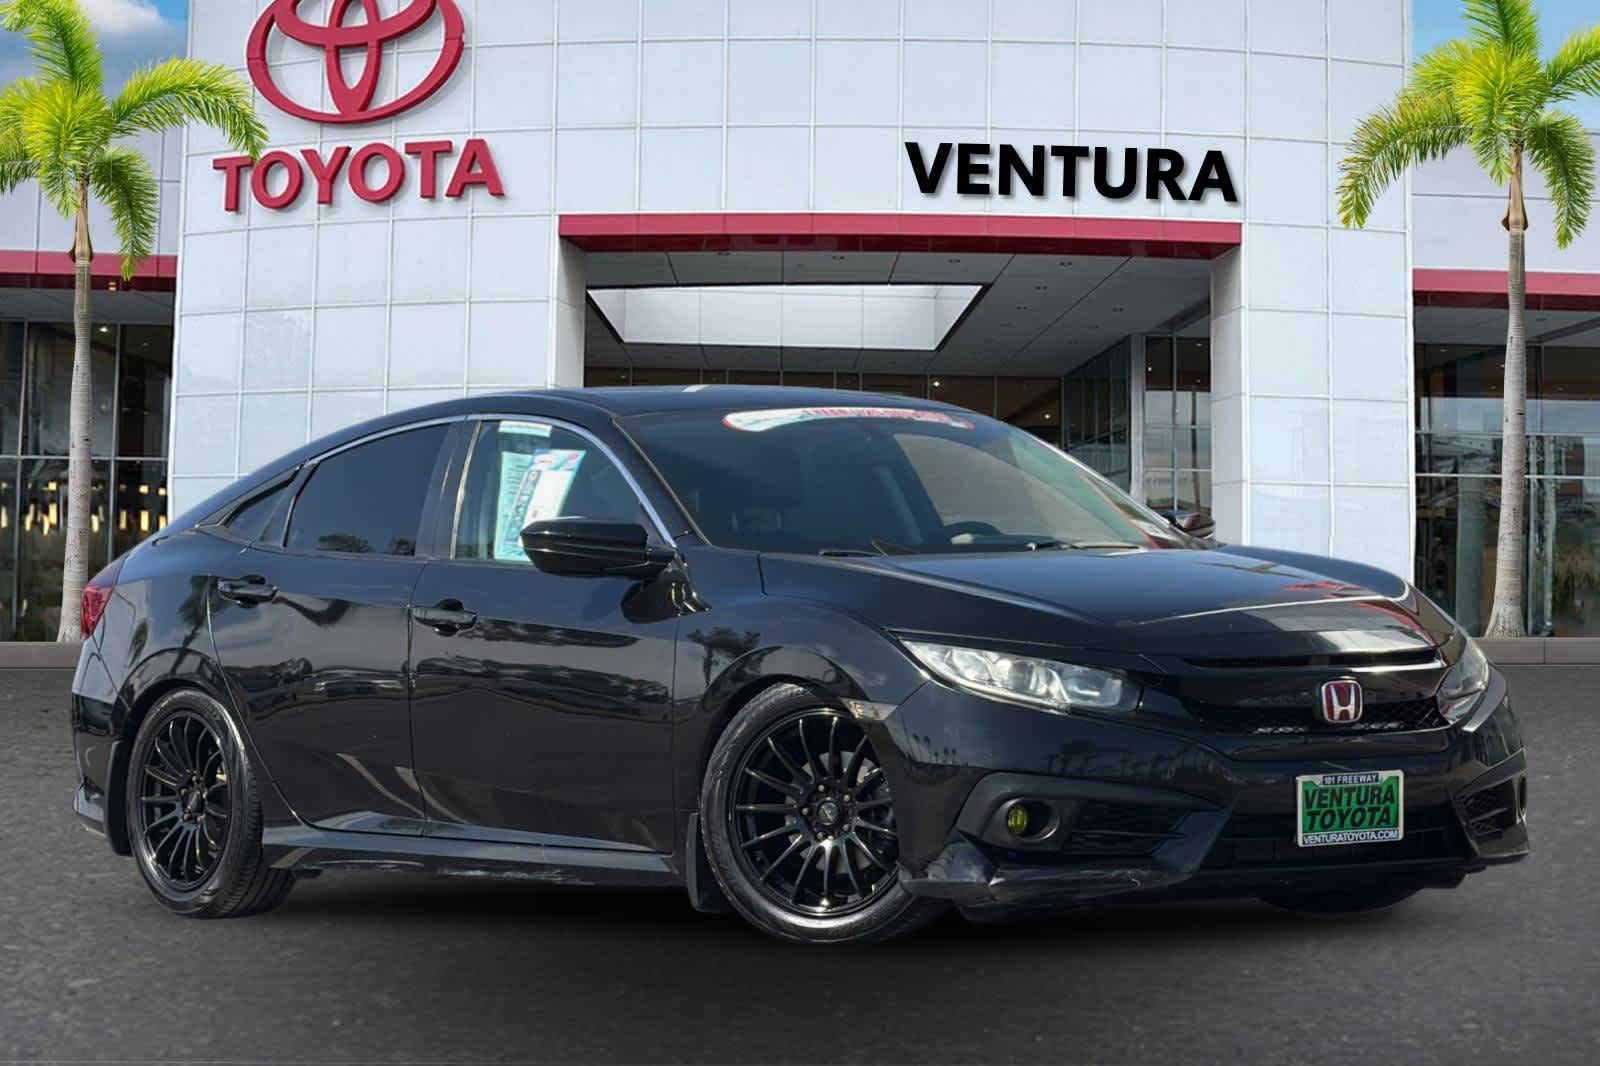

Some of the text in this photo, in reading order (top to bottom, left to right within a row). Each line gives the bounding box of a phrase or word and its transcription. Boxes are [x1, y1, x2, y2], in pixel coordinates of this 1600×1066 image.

[212, 138, 505, 212] TOYOTA
[904, 141, 1238, 203] VENTURA
[1337, 774, 1377, 784] FREEWAY
[1304, 784, 1396, 810] VENTURA
[1306, 805, 1392, 831] TOYOTA
[1303, 829, 1398, 845] VENTURATOYOTA.COM
